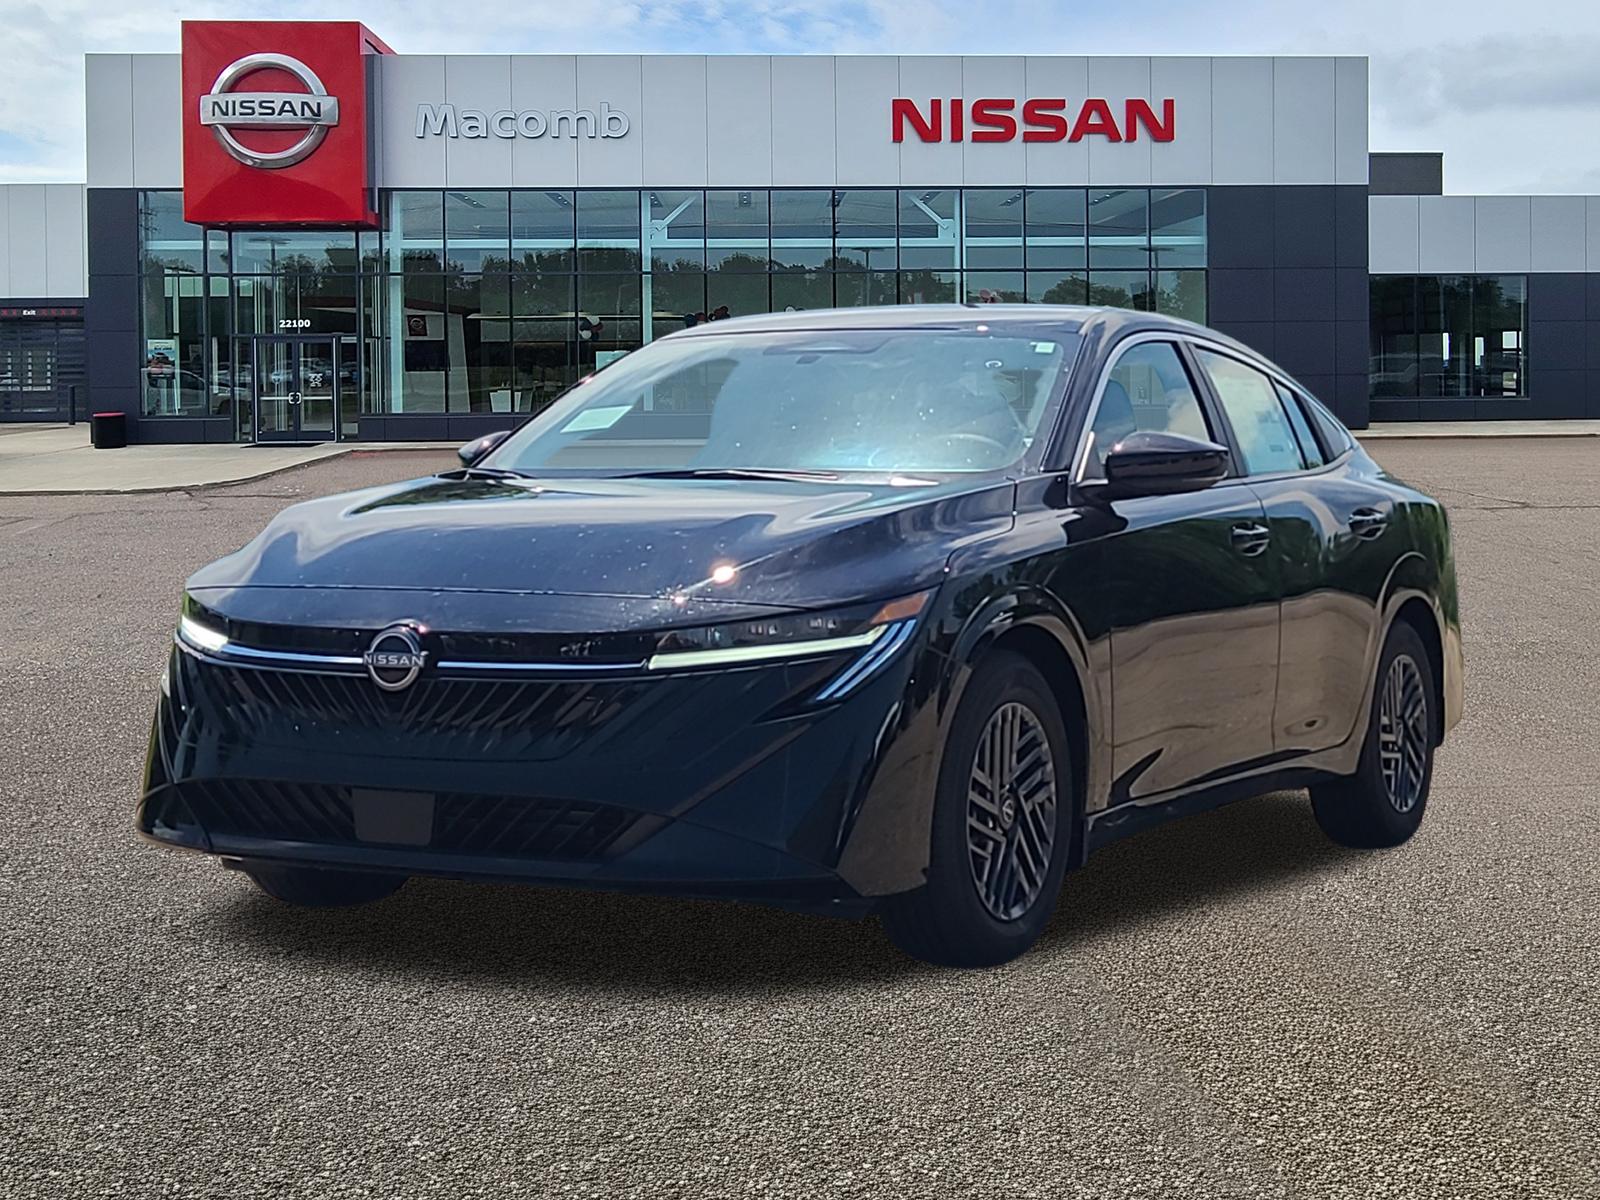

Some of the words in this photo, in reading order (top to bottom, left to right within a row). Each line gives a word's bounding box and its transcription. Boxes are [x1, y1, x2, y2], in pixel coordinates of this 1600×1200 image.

[212, 100, 322, 117] NISSAN
[415, 101, 630, 139] Macomb
[892, 98, 1175, 142] NISSAN
[279, 319, 311, 328] 22100
[364, 653, 424, 667] NISSAN
